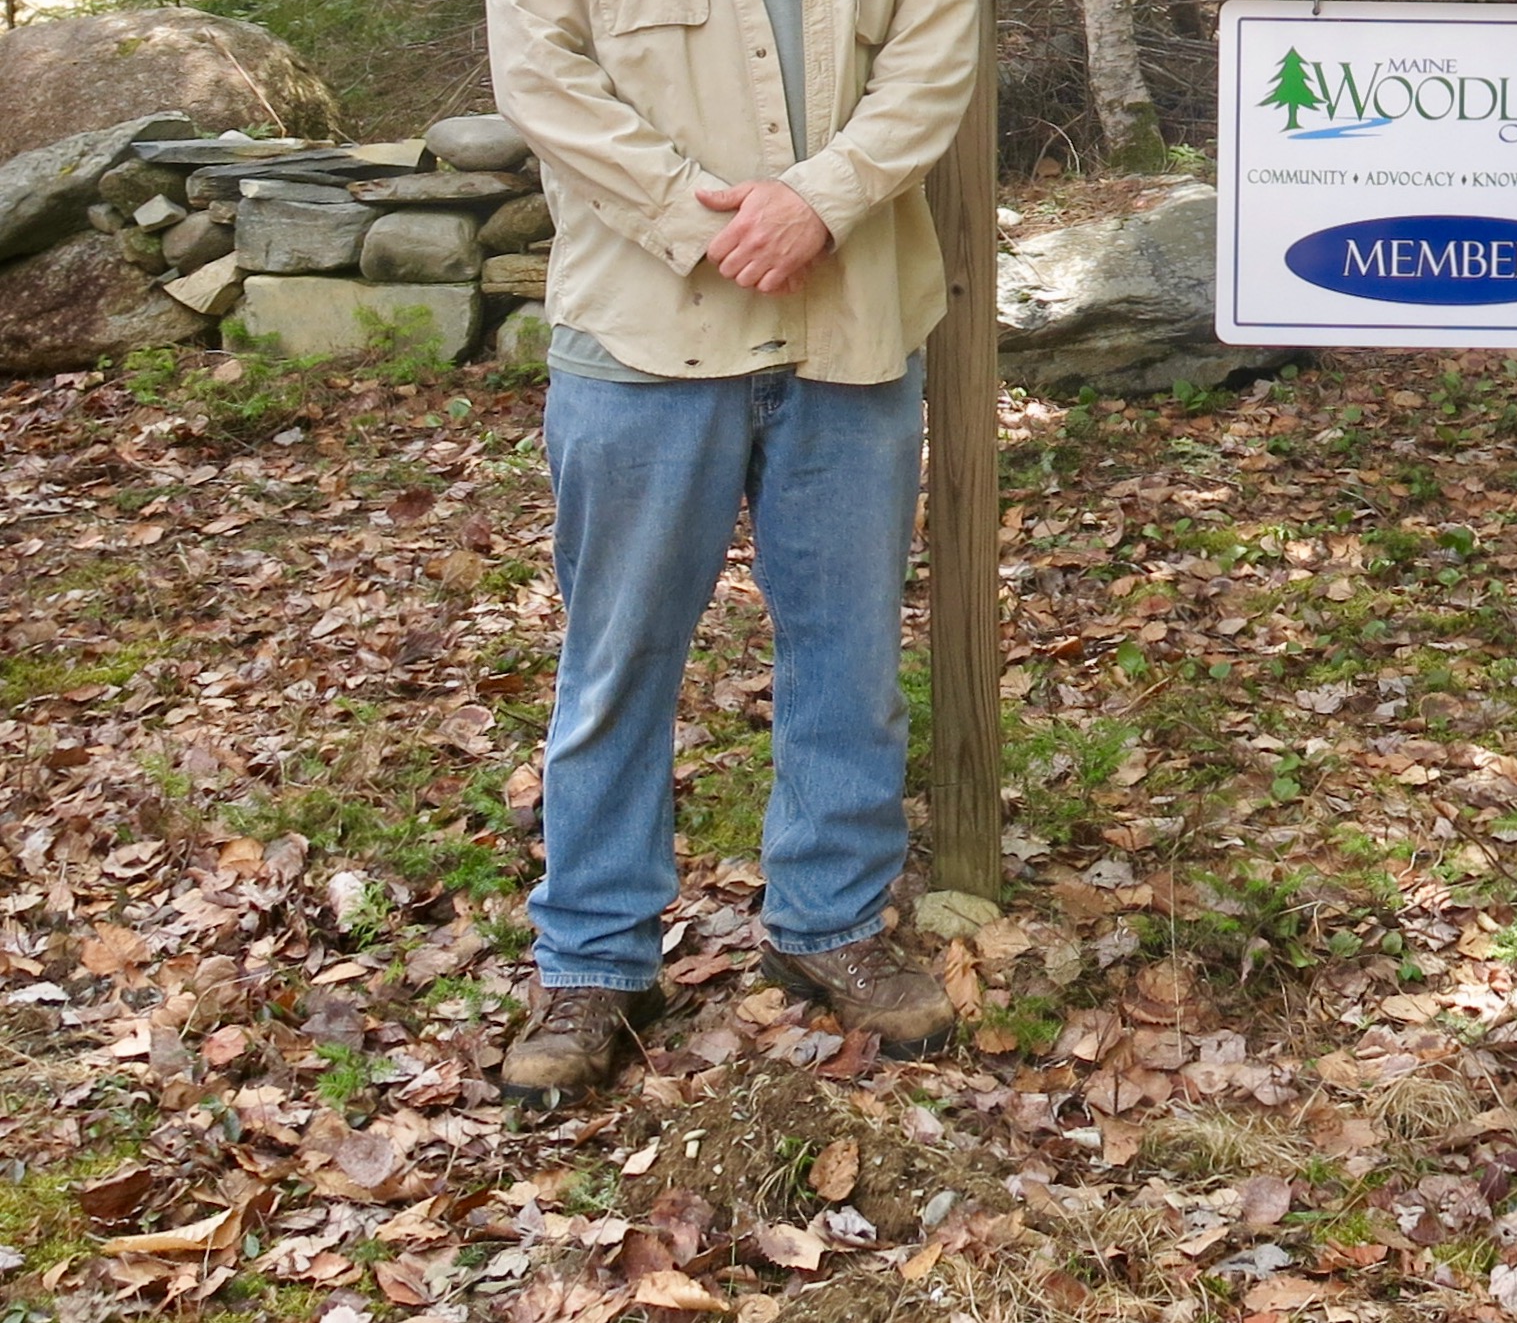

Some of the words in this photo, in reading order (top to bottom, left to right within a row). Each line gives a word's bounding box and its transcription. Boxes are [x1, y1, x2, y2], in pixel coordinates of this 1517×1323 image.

[1387, 57, 1458, 75] MAINE
[1246, 168, 1348, 186] COMMUNITY
[1364, 170, 1456, 188] ADVOCACY
